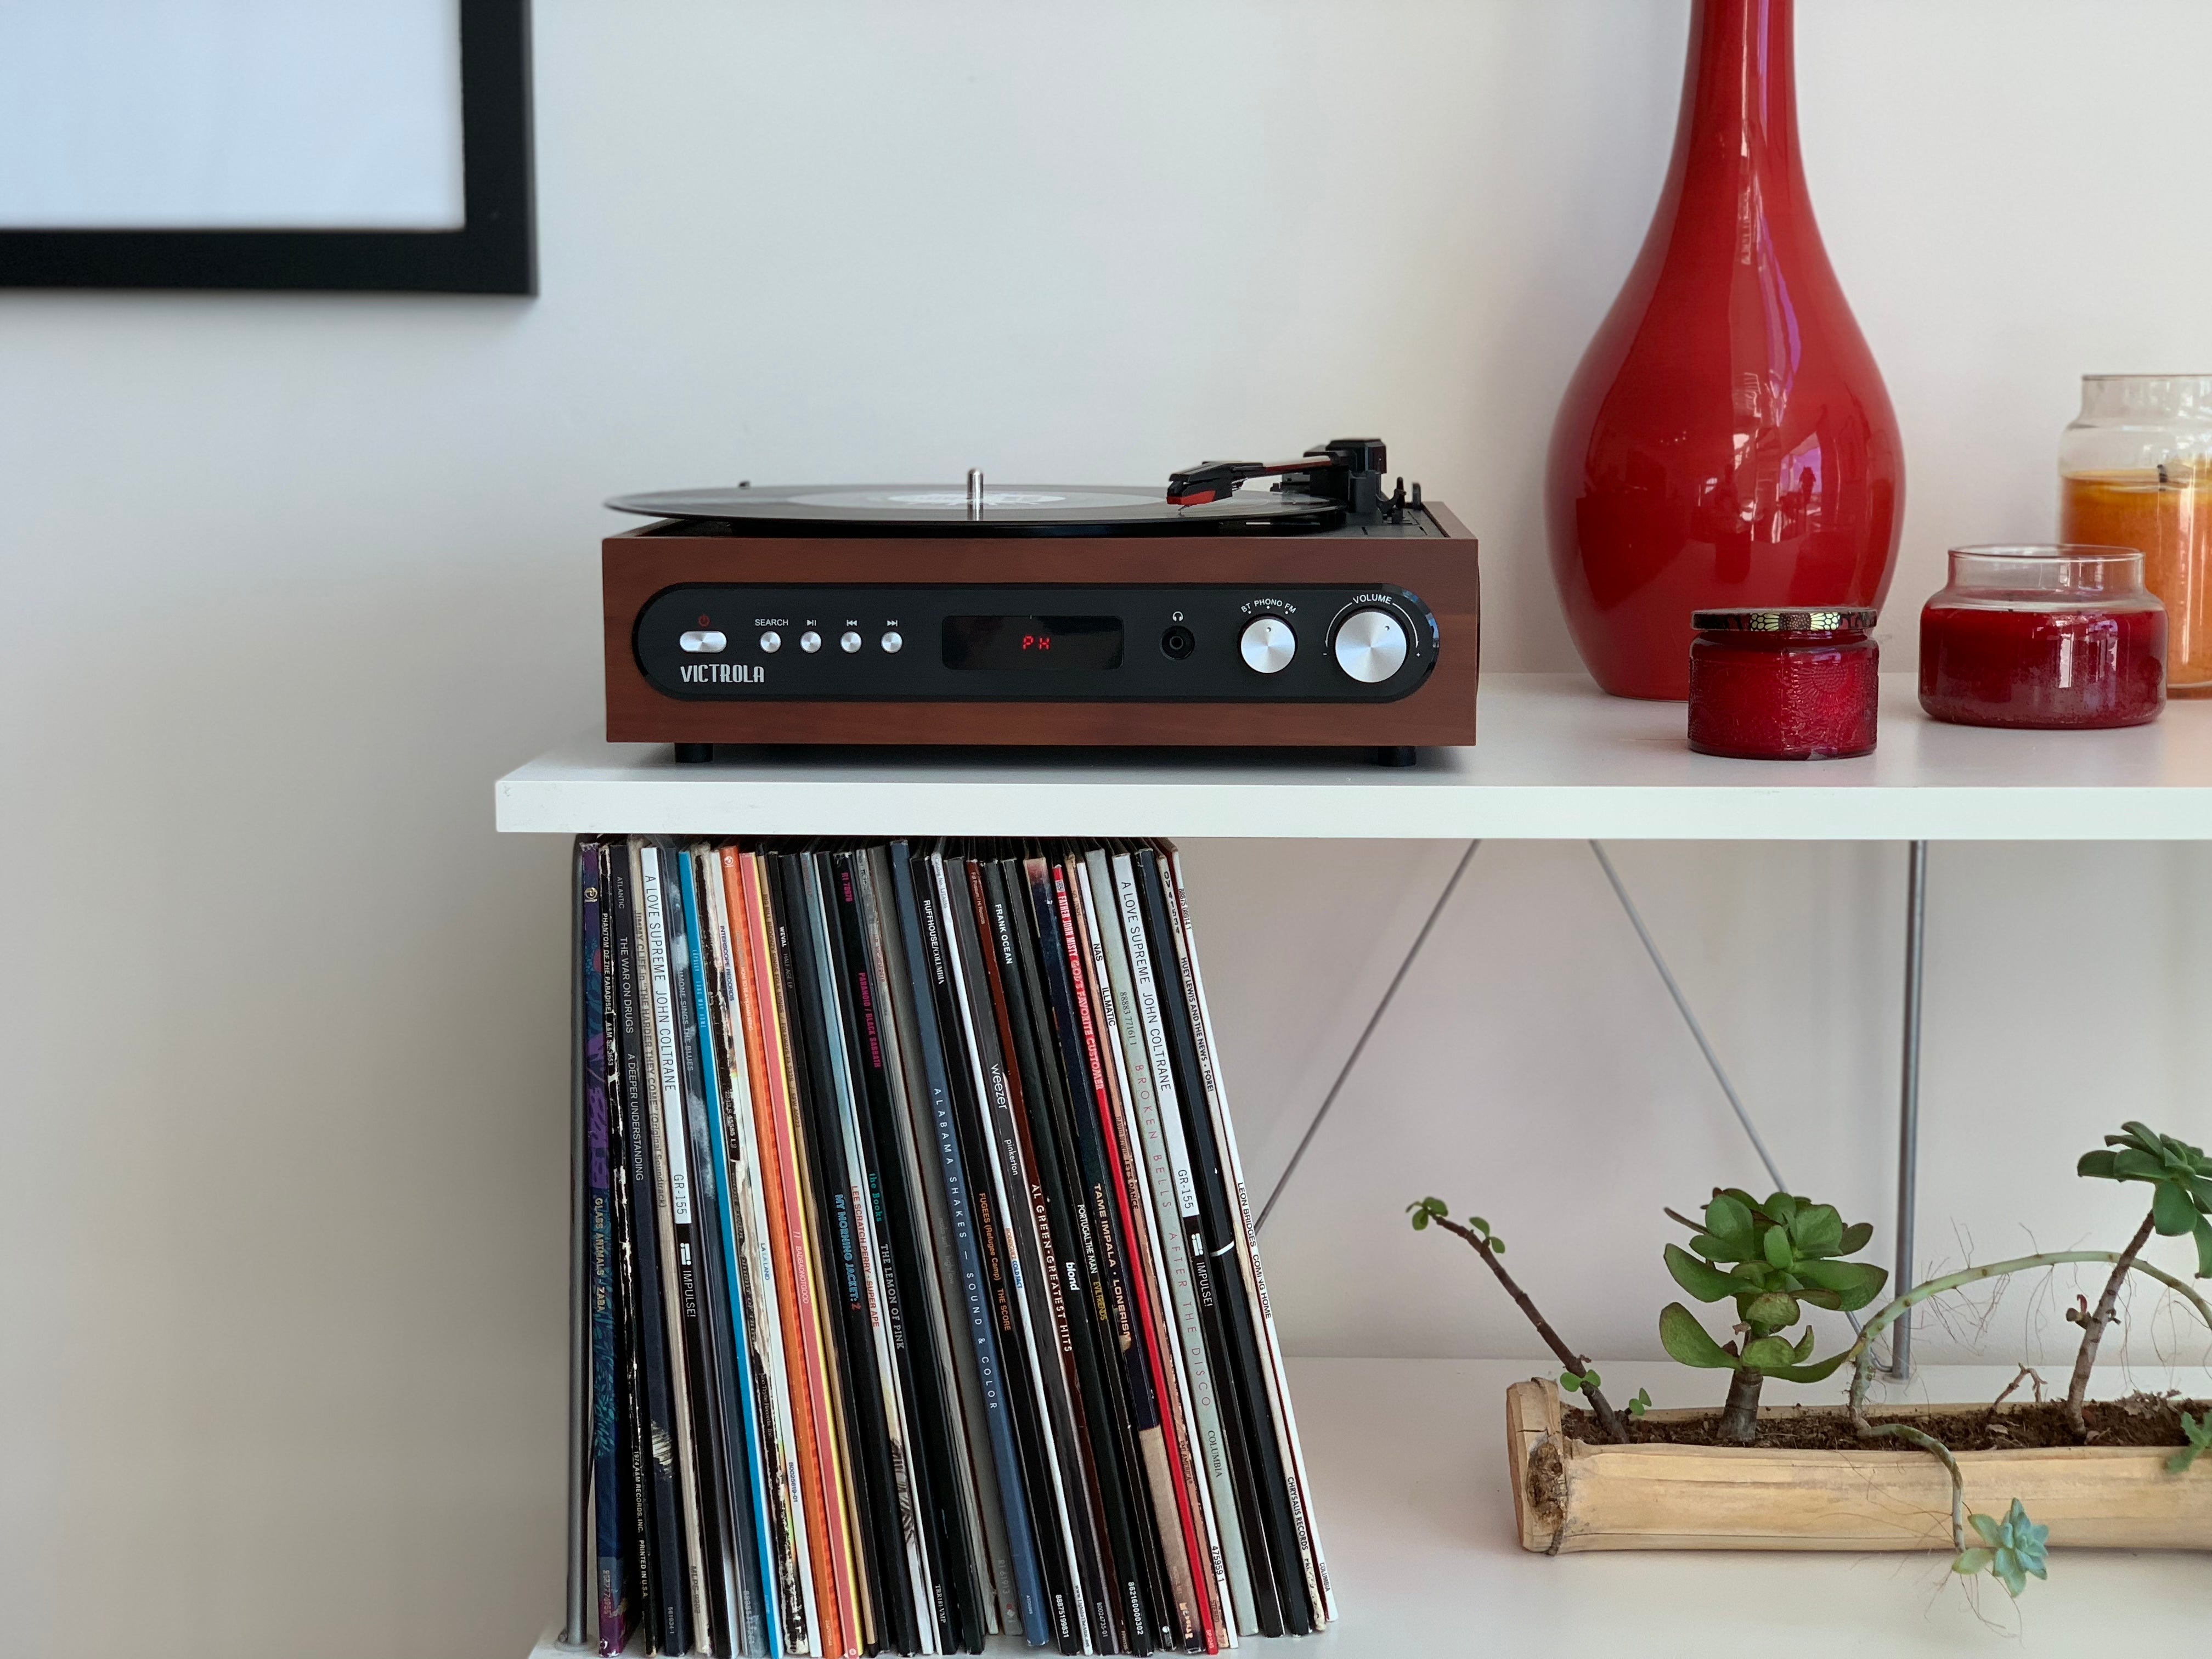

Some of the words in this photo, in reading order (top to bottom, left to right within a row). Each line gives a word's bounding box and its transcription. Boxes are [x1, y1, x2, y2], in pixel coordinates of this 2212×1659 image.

[1240, 602, 1251, 613] BT
[1254, 598, 1283, 607] PHONO
[1284, 603, 1296, 613] FM
[1352, 593, 1393, 605] VOLUME
[754, 617, 789, 627] SEARCH
[1023, 635, 1049, 650] PH
[680, 663, 765, 683] VICTROLA
[616, 876, 625, 909] ATLANTIC
[646, 888, 660, 917] LOVE
[762, 894, 770, 905] BIG
[1057, 895, 1071, 918] FATHER
[764, 906, 772, 920] BILL
[994, 903, 1007, 932] FRANK
[1122, 893, 1139, 923] LOVE
[600, 912, 610, 948] PHANTOM
[765, 921, 776, 951] BROONZY
[778, 926, 788, 947] WEVAL
[922, 899, 945, 984] RUFFHOUSE/COLUMBIA
[1061, 919, 1075, 937] JOHN
[602, 949, 611, 960] OF
[619, 936, 629, 956] THE
[648, 922, 666, 981] SUPREME
[782, 953, 791, 967] HALF
[999, 934, 1013, 964] OCEAN
[1064, 937, 1079, 956] MISTY
[1128, 927, 1151, 984] SUPREME
[602, 961, 611, 974] THE
[620, 957, 631, 979] WAR
[719, 925, 730, 967] INTERSCOPE
[725, 968, 734, 1001] RECORDS
[770, 952, 779, 972] SINGS
[784, 968, 792, 980] AGE
[1069, 959, 1085, 989] GOD'S
[1180, 957, 1192, 978] HUEY
[603, 976, 613, 1011] PARADISE
[622, 982, 632, 997] ON
[676, 967, 686, 998] SIMONE
[772, 974, 782, 990] FOLK
[786, 981, 793, 989] EP
[857, 972, 872, 1006] PARANOID
[1092, 943, 1103, 962] NAS
[1100, 987, 1116, 1026] ILLMATIC
[1184, 979, 1197, 1003] LEWIS
[654, 990, 670, 1023] JOHN
[680, 1000, 689, 1025] SINGS
[775, 991, 785, 1013] SONGS
[1075, 991, 1094, 1036] FAVORITE
[1118, 991, 1132, 1015] 88883
[1142, 992, 1159, 1024] JOHN
[1189, 1004, 1200, 1022] AND
[623, 999, 634, 1034] DRUGS
[864, 1013, 877, 1035] BLACK
[1123, 1017, 1137, 1039] 77161
[1193, 1024, 1204, 1037] THE
[682, 1026, 691, 1044] THE
[778, 1022, 790, 1055] FOLKWAYS
[626, 1053, 636, 1062] A
[658, 1028, 676, 1091] COLTRANE
[684, 1045, 694, 1071] BLUES
[783, 1056, 792, 1064] FA
[867, 1037, 882, 1068] SABBATH
[1083, 1037, 1104, 1090] CUSTOMER
[1148, 1028, 1172, 1091] COLTRANE
[1196, 1039, 1209, 1061] NEWS
[627, 1062, 639, 1099] DEEPER
[989, 1063, 1008, 1109] weezer
[1202, 1069, 1215, 1092] FORE!
[788, 1092, 797, 1107] SFW
[629, 1101, 644, 1181] UNDERSTANDING
[1004, 1139, 1020, 1176] pinkerton
[1122, 1158, 1134, 1181] LET'S
[673, 1173, 687, 1215] GR-155
[850, 1186, 862, 1201] LEE
[868, 1172, 879, 1188] the
[1030, 1184, 1044, 1199] AL
[1176, 1169, 1195, 1209] GR-155
[833, 1194, 847, 1209] MY
[871, 1193, 885, 1222] Books
[977, 1193, 992, 1223] FUGEES
[1092, 1183, 1109, 1218] TAME
[1126, 1182, 1139, 1210] DANCE
[1237, 1182, 1249, 1207] LEON
[592, 1198, 605, 1229] GLASS
[853, 1203, 868, 1244] SCRATCH
[1242, 1208, 1257, 1247] BRIDGES
[759, 1243, 766, 1251] LA
[836, 1211, 854, 1261] MORNING
[933, 1087, 956, 1165] ALABAMA
[949, 1176, 968, 1239] SHAKES
[964, 1272, 983, 1326] SOUND
[979, 1356, 997, 1409] COLOR
[983, 1224, 998, 1256] (Refugee
[1004, 1227, 1017, 1260] RODRIGUEZ
[1099, 1220, 1118, 1268] IMPALA
[1133, 1064, 1159, 1139] BROKEN
[1151, 1155, 1172, 1208] BELLS
[1166, 1232, 1188, 1288] AFTER
[1179, 1301, 1197, 1334] THE
[1188, 1347, 1211, 1407] DISCO
[594, 1232, 606, 1276] ANIMALS
[760, 1252, 768, 1262] LA
[859, 1245, 872, 1274] PERRY
[878, 1244, 891, 1263] THE
[1034, 1205, 1066, 1319] GREEN-GREATEST
[761, 1262, 770, 1281] LAND
[988, 1257, 1002, 1281] Camp)
[1010, 1260, 1020, 1276] COLD
[1064, 1262, 1080, 1290] blond
[682, 1269, 697, 1317] IMPULSE!
[843, 1263, 860, 1302] JACKET:
[864, 1279, 877, 1308] SUPER
[882, 1267, 897, 1304] LEMON
[994, 1288, 1006, 1303] THE
[1013, 1276, 1023, 1289] FACT
[1195, 1262, 1214, 1307] IMPULSE!
[596, 1286, 608, 1312] ZABA
[1094, 1294, 1108, 1321] FRIENDS
[1110, 1279, 1132, 1341] LONERISM
[1260, 1292, 1272, 1319] HOME
[868, 1310, 880, 1327] APE
[888, 1307, 900, 1321] OF
[996, 1305, 1011, 1331] SCORE
[890, 1324, 904, 1350] PINK
[1056, 1324, 1072, 1352] HITS
[1206, 1430, 1224, 1478] COLUMBIA
[787, 1462, 799, 1503] B0025619-01
[1286, 1476, 1302, 1515] CHRYSALIS
[1294, 1516, 1309, 1551] RECORDS
[1210, 1545, 1223, 1576] 475959
[1318, 1561, 1331, 1592] COLUMBIA
[1054, 1594, 1070, 1638] 88875199831
[1127, 1582, 1144, 1635] 862160000302
[1209, 1599, 1221, 1623] STEREO
